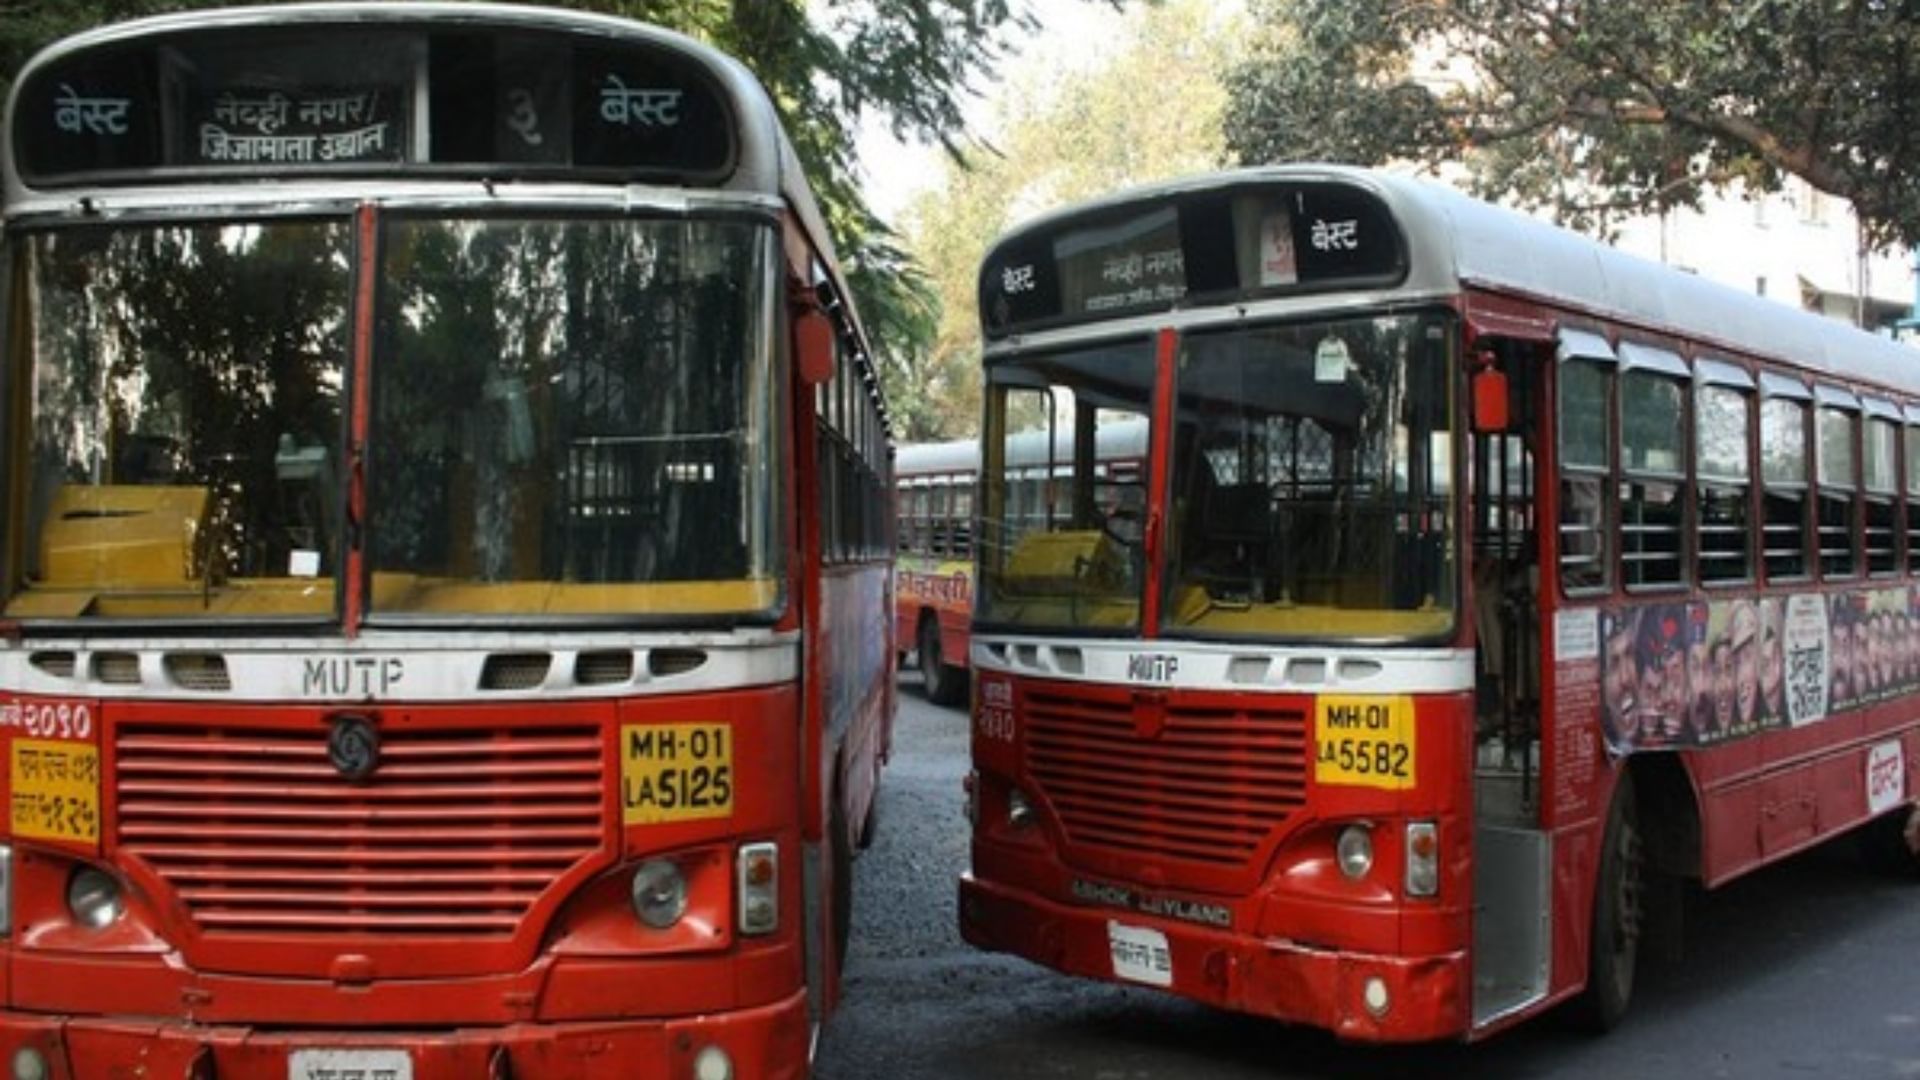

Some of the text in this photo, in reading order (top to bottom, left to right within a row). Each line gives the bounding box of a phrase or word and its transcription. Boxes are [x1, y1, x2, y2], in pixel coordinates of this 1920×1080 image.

[55, 83, 129, 135] बेस्ट
[600, 73, 682, 126] बेस्ट
[1311, 219, 1358, 250] बेस्ट
[303, 658, 402, 694] MUTP
[1129, 654, 1178, 681] MUTP
